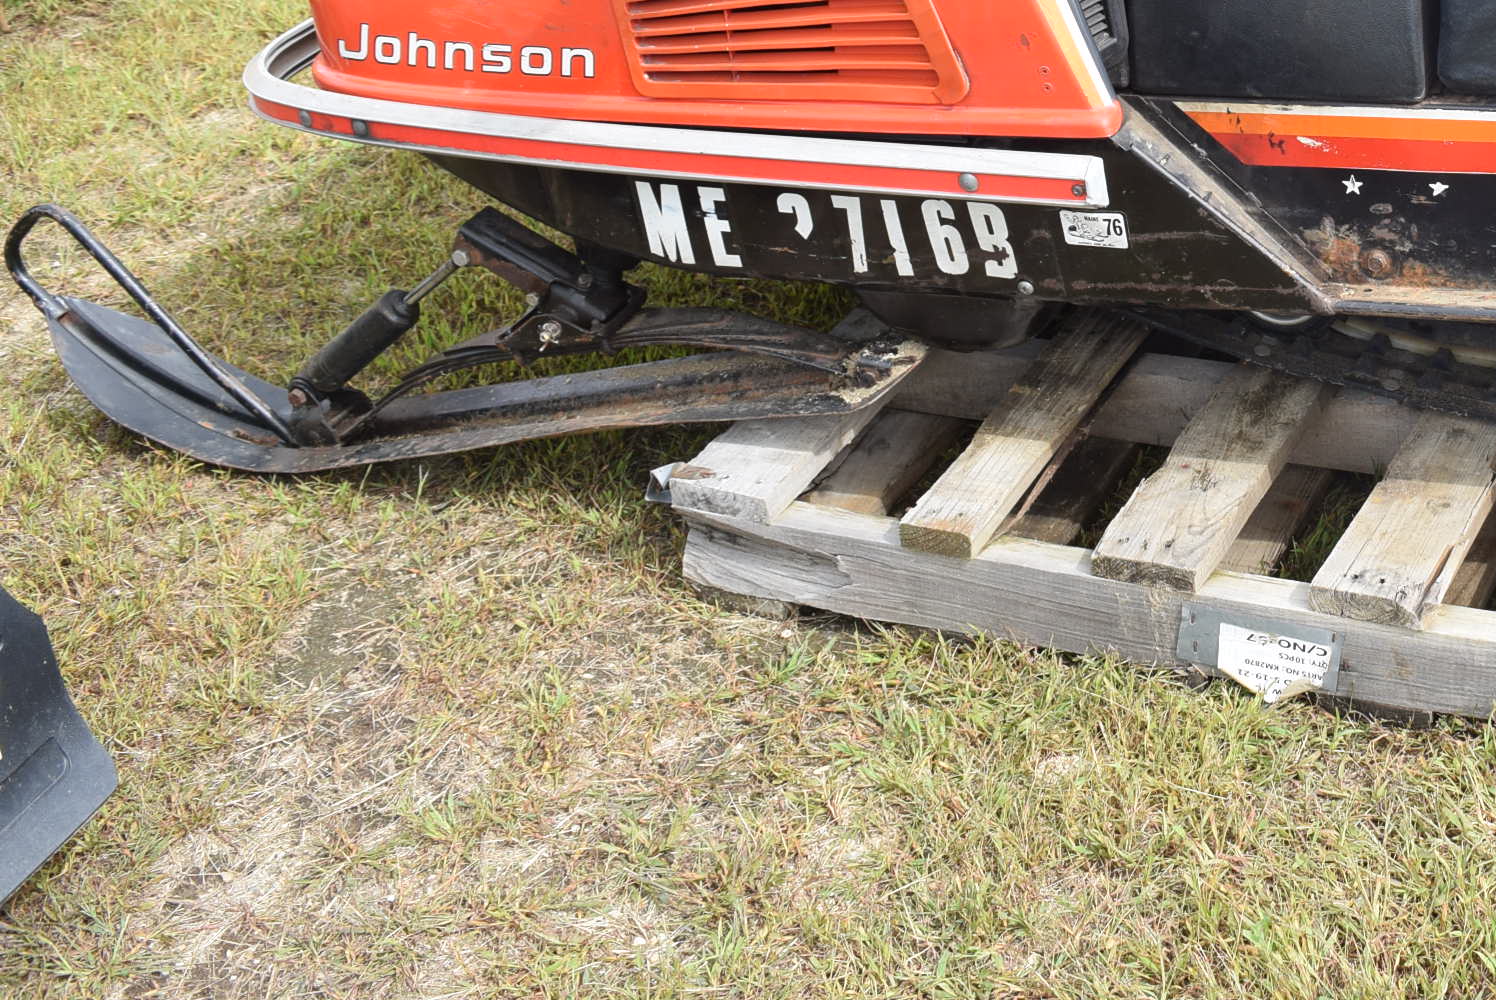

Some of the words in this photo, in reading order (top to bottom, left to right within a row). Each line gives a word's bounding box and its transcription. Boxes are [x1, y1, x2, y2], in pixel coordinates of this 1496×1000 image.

[337, 23, 596, 79] Johnson
[635, 180, 743, 268] ME
[1102, 218, 1123, 237] 76
